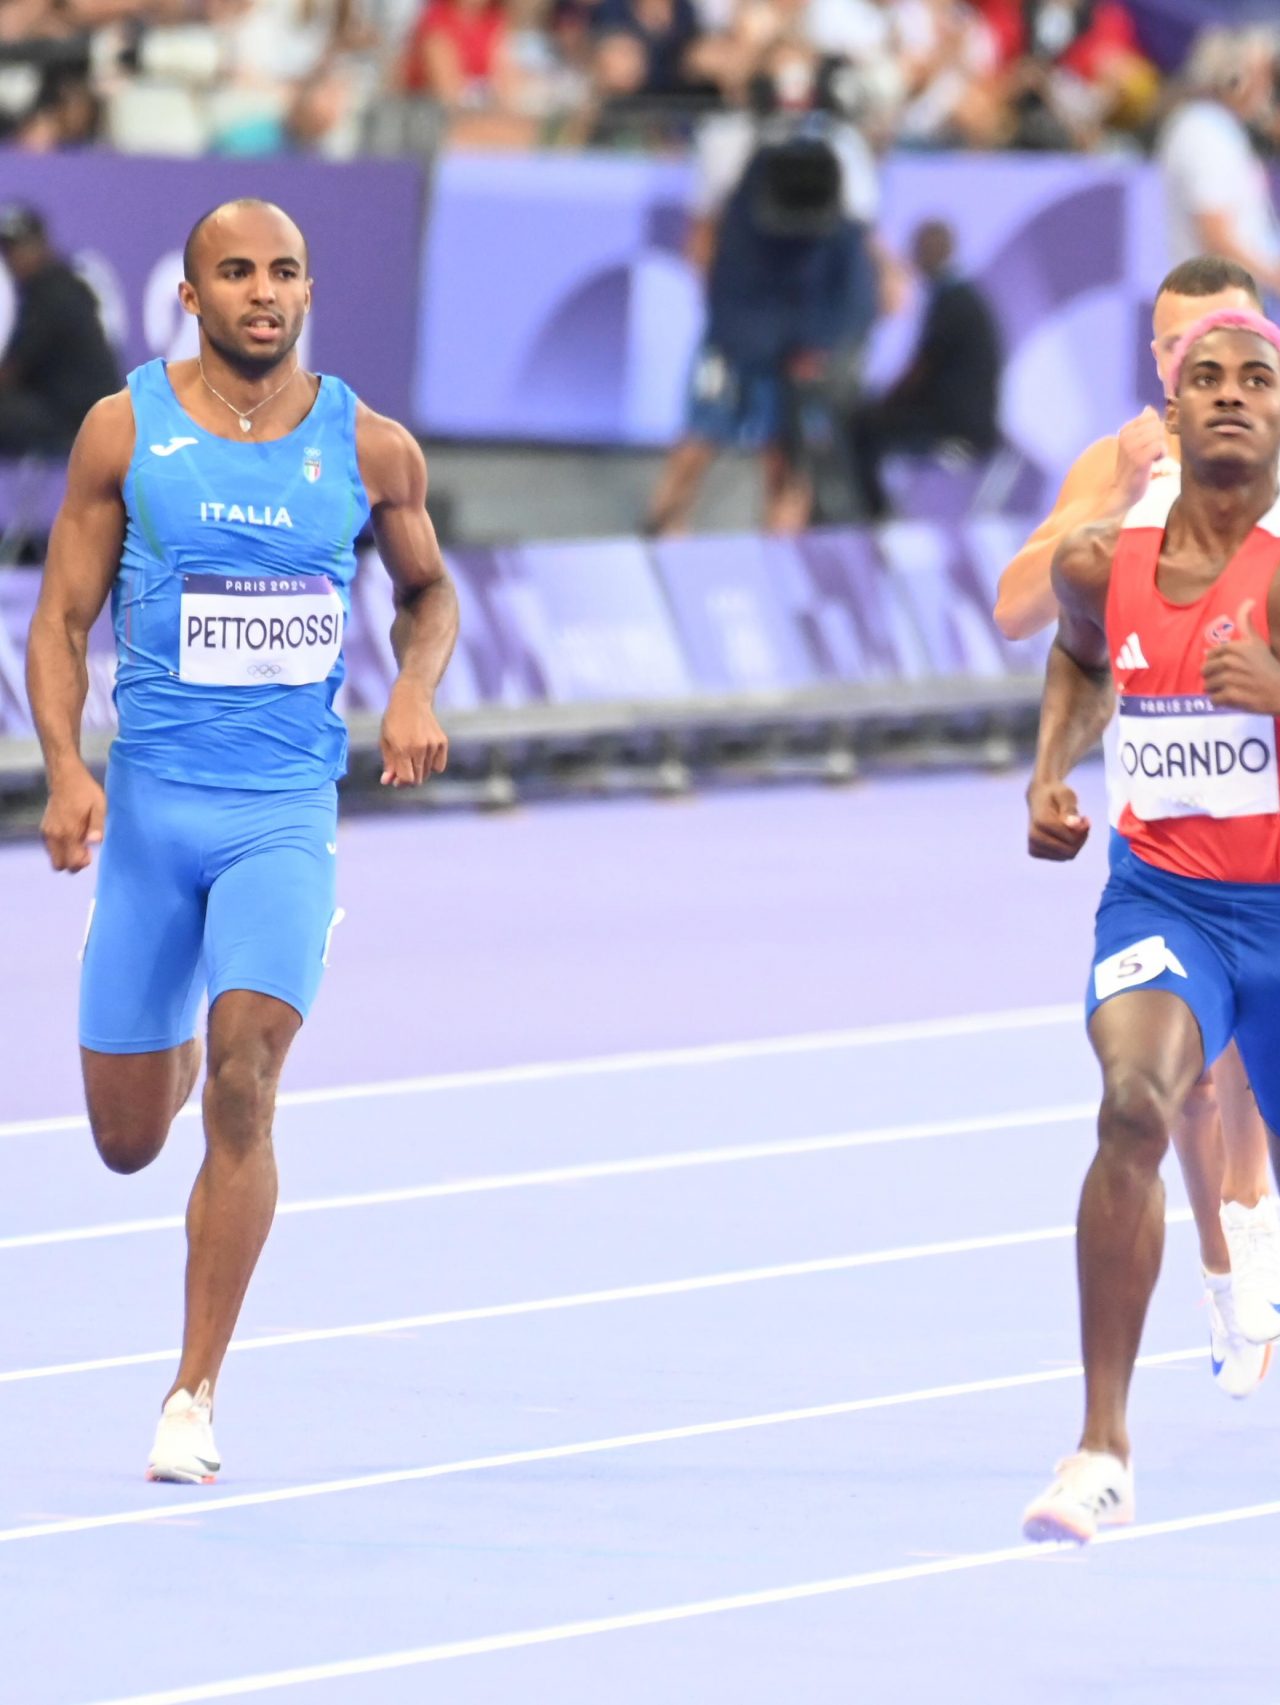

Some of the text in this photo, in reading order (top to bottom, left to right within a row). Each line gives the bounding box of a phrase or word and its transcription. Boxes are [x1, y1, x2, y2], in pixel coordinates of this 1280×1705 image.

[200, 501, 293, 528] ITALIA
[225, 579, 307, 592] PARIS 2024
[187, 613, 339, 650] PETTOROSSI
[1140, 698, 1181, 713] PARIS
[1120, 737, 1270, 778] OGANDO
[1116, 952, 1143, 979] 5
